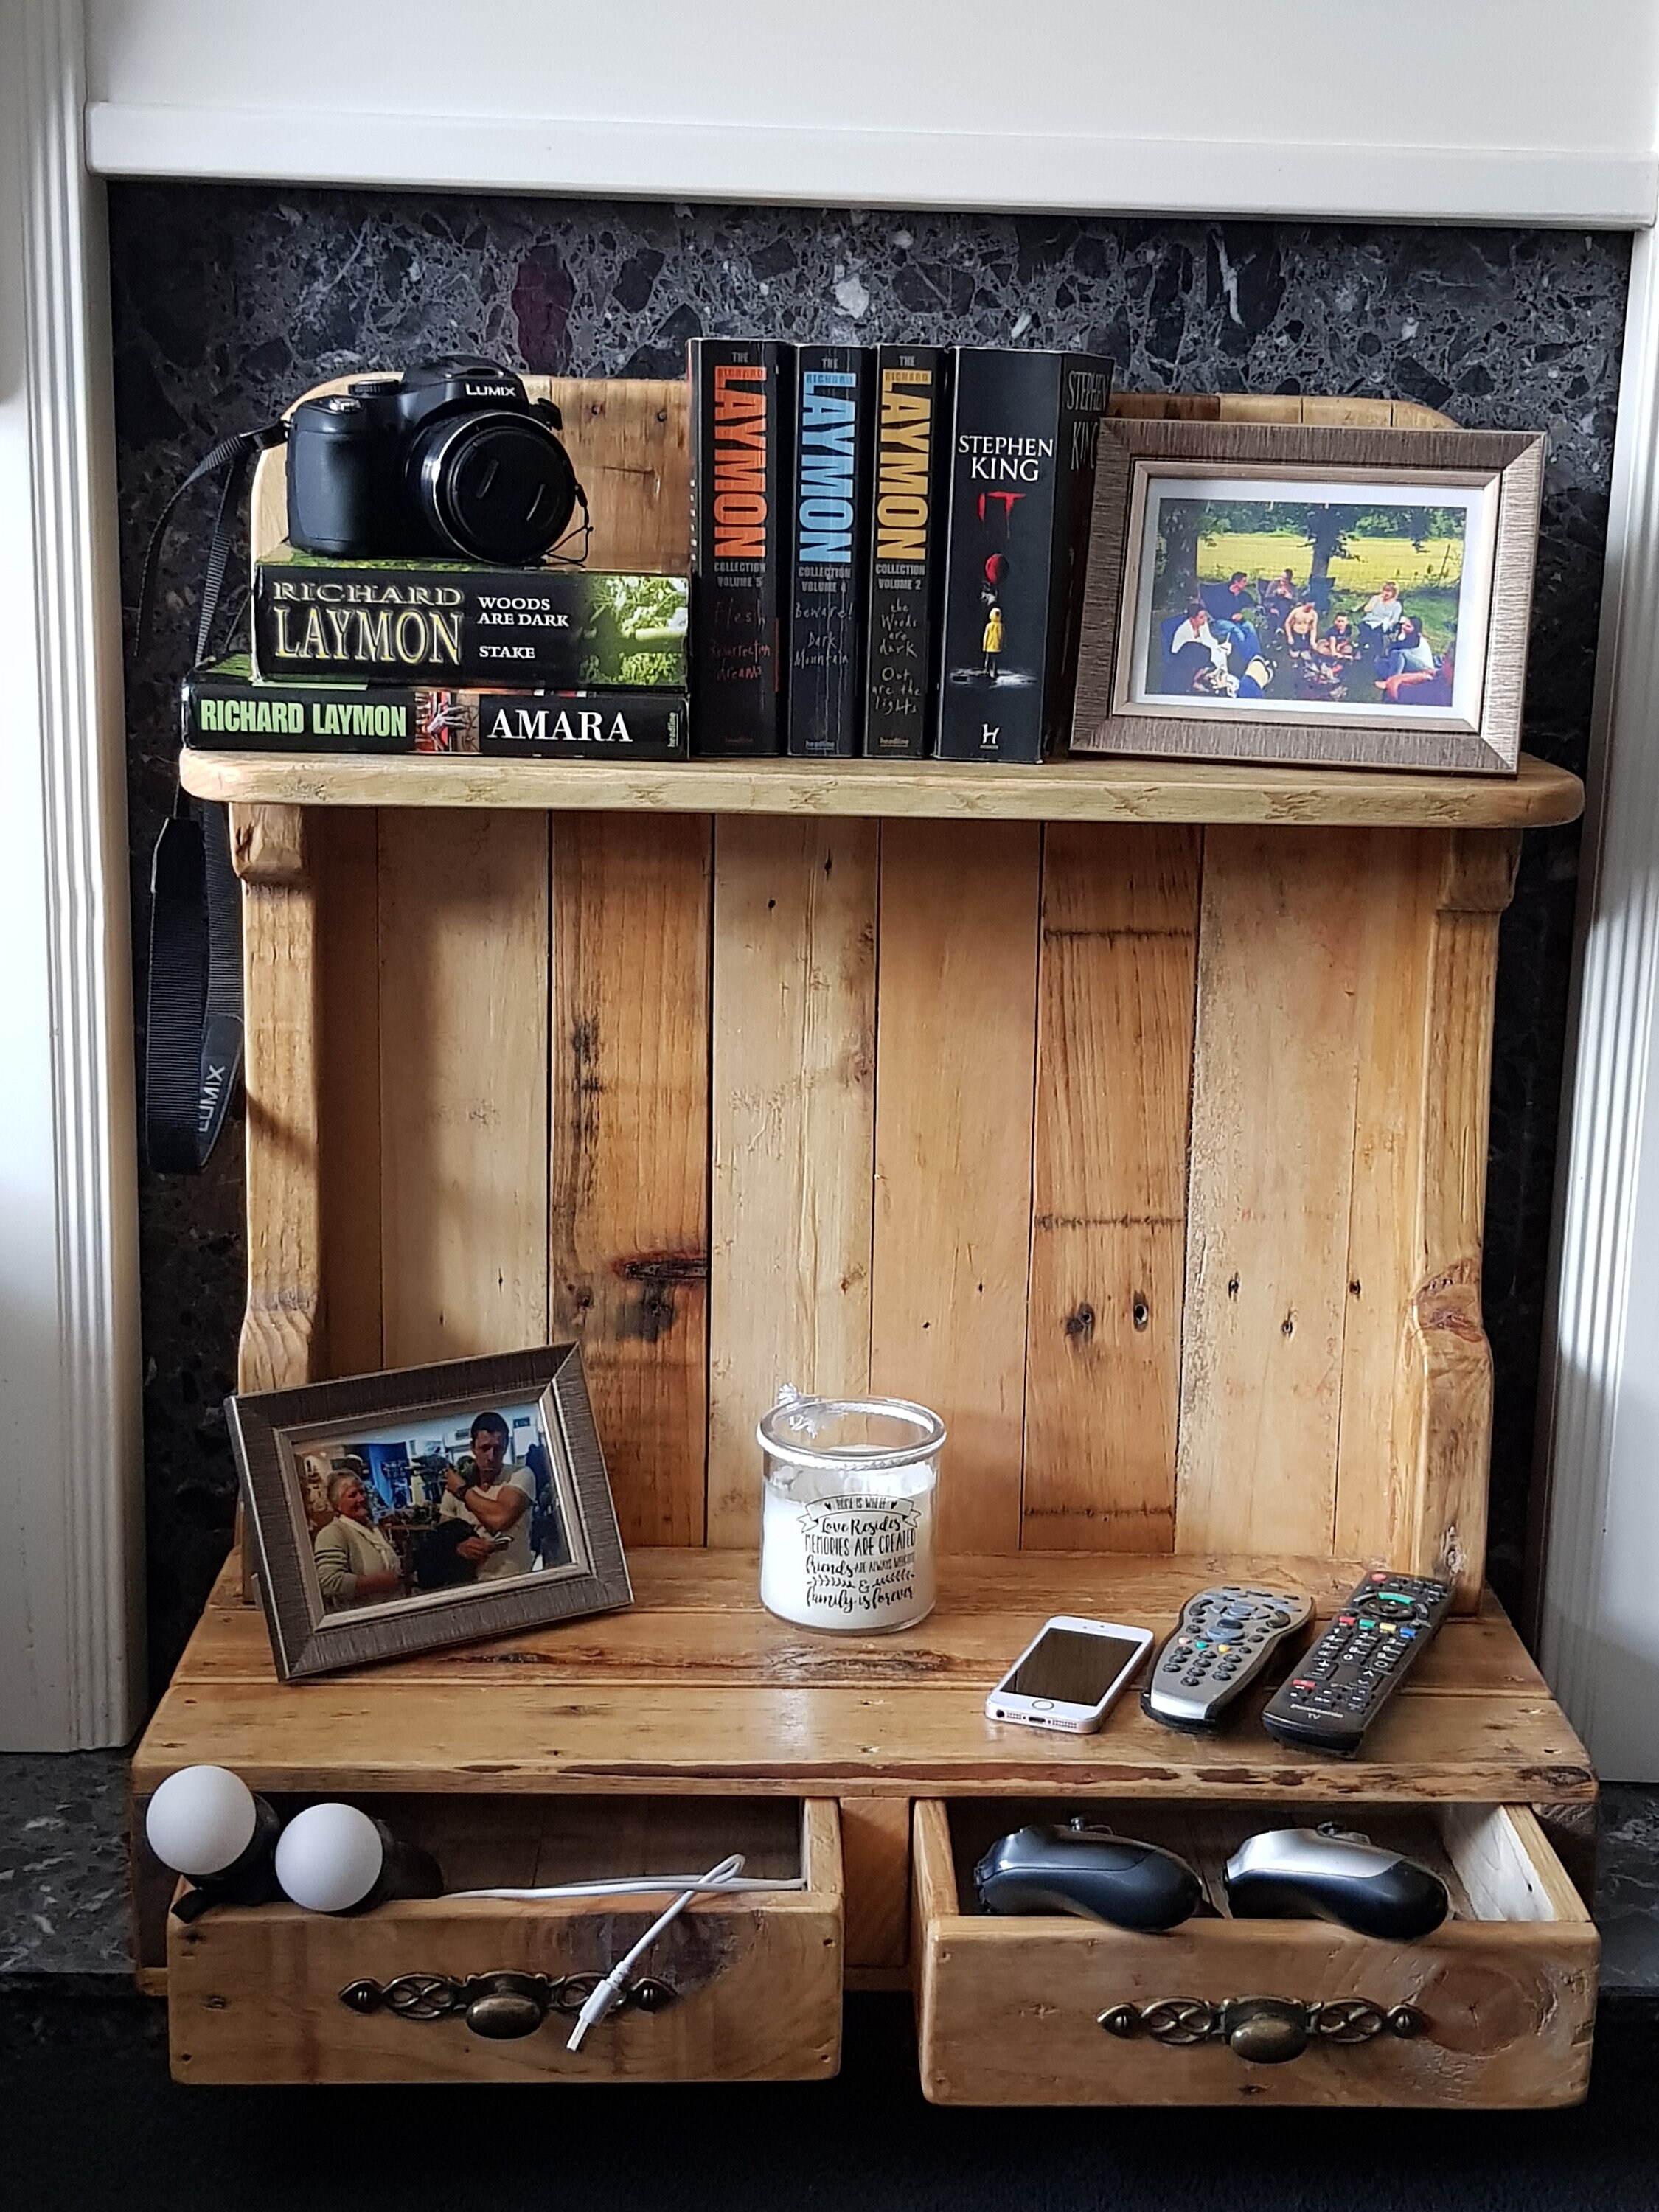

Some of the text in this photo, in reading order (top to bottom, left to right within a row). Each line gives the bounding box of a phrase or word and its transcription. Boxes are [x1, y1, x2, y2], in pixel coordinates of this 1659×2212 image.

[732, 352, 748, 363] THE
[822, 358, 838, 369] THE
[900, 355, 915, 366] THE
[885, 371, 928, 382] RICHARD
[465, 383, 515, 397] LUMIX
[958, 435, 1054, 457] STEPHEN
[714, 366, 767, 557] LAYMON
[799, 372, 856, 563] LAYMON
[877, 369, 931, 560] LAYMON
[971, 456, 1039, 481] KING
[978, 490, 1027, 534] IT
[714, 562, 765, 573] COLLECTION
[799, 566, 851, 578] COLLECTION
[875, 564, 925, 575] COLLECTION
[717, 577, 752, 588] VOLUME
[801, 581, 837, 593] VOLUME
[878, 579, 921, 590] VOLUME 2
[273, 582, 465, 606] RICHARD
[478, 597, 551, 611] WOODS
[795, 602, 853, 621] Beware!
[891, 597, 909, 613] the
[477, 613, 570, 627] ARE DARK
[273, 606, 464, 665] LAYMON
[807, 632, 837, 648] Dark
[889, 631, 908, 641] are
[479, 646, 535, 659] STAKE
[880, 639, 918, 658] dark
[882, 667, 910, 681] Out
[872, 680, 921, 696] are the
[875, 697, 917, 715] lights
[201, 700, 406, 737] RICHARD LAYMON
[487, 709, 633, 742] AMARA
[198, 1065, 225, 1132] LUMIX
[822, 1516, 901, 1537] Love Resides
[805, 1528, 916, 1557] MEMORIES ARE CREATED
[858, 1579, 869, 1593] &
[1290, 1703, 1344, 1719] Panasonic
